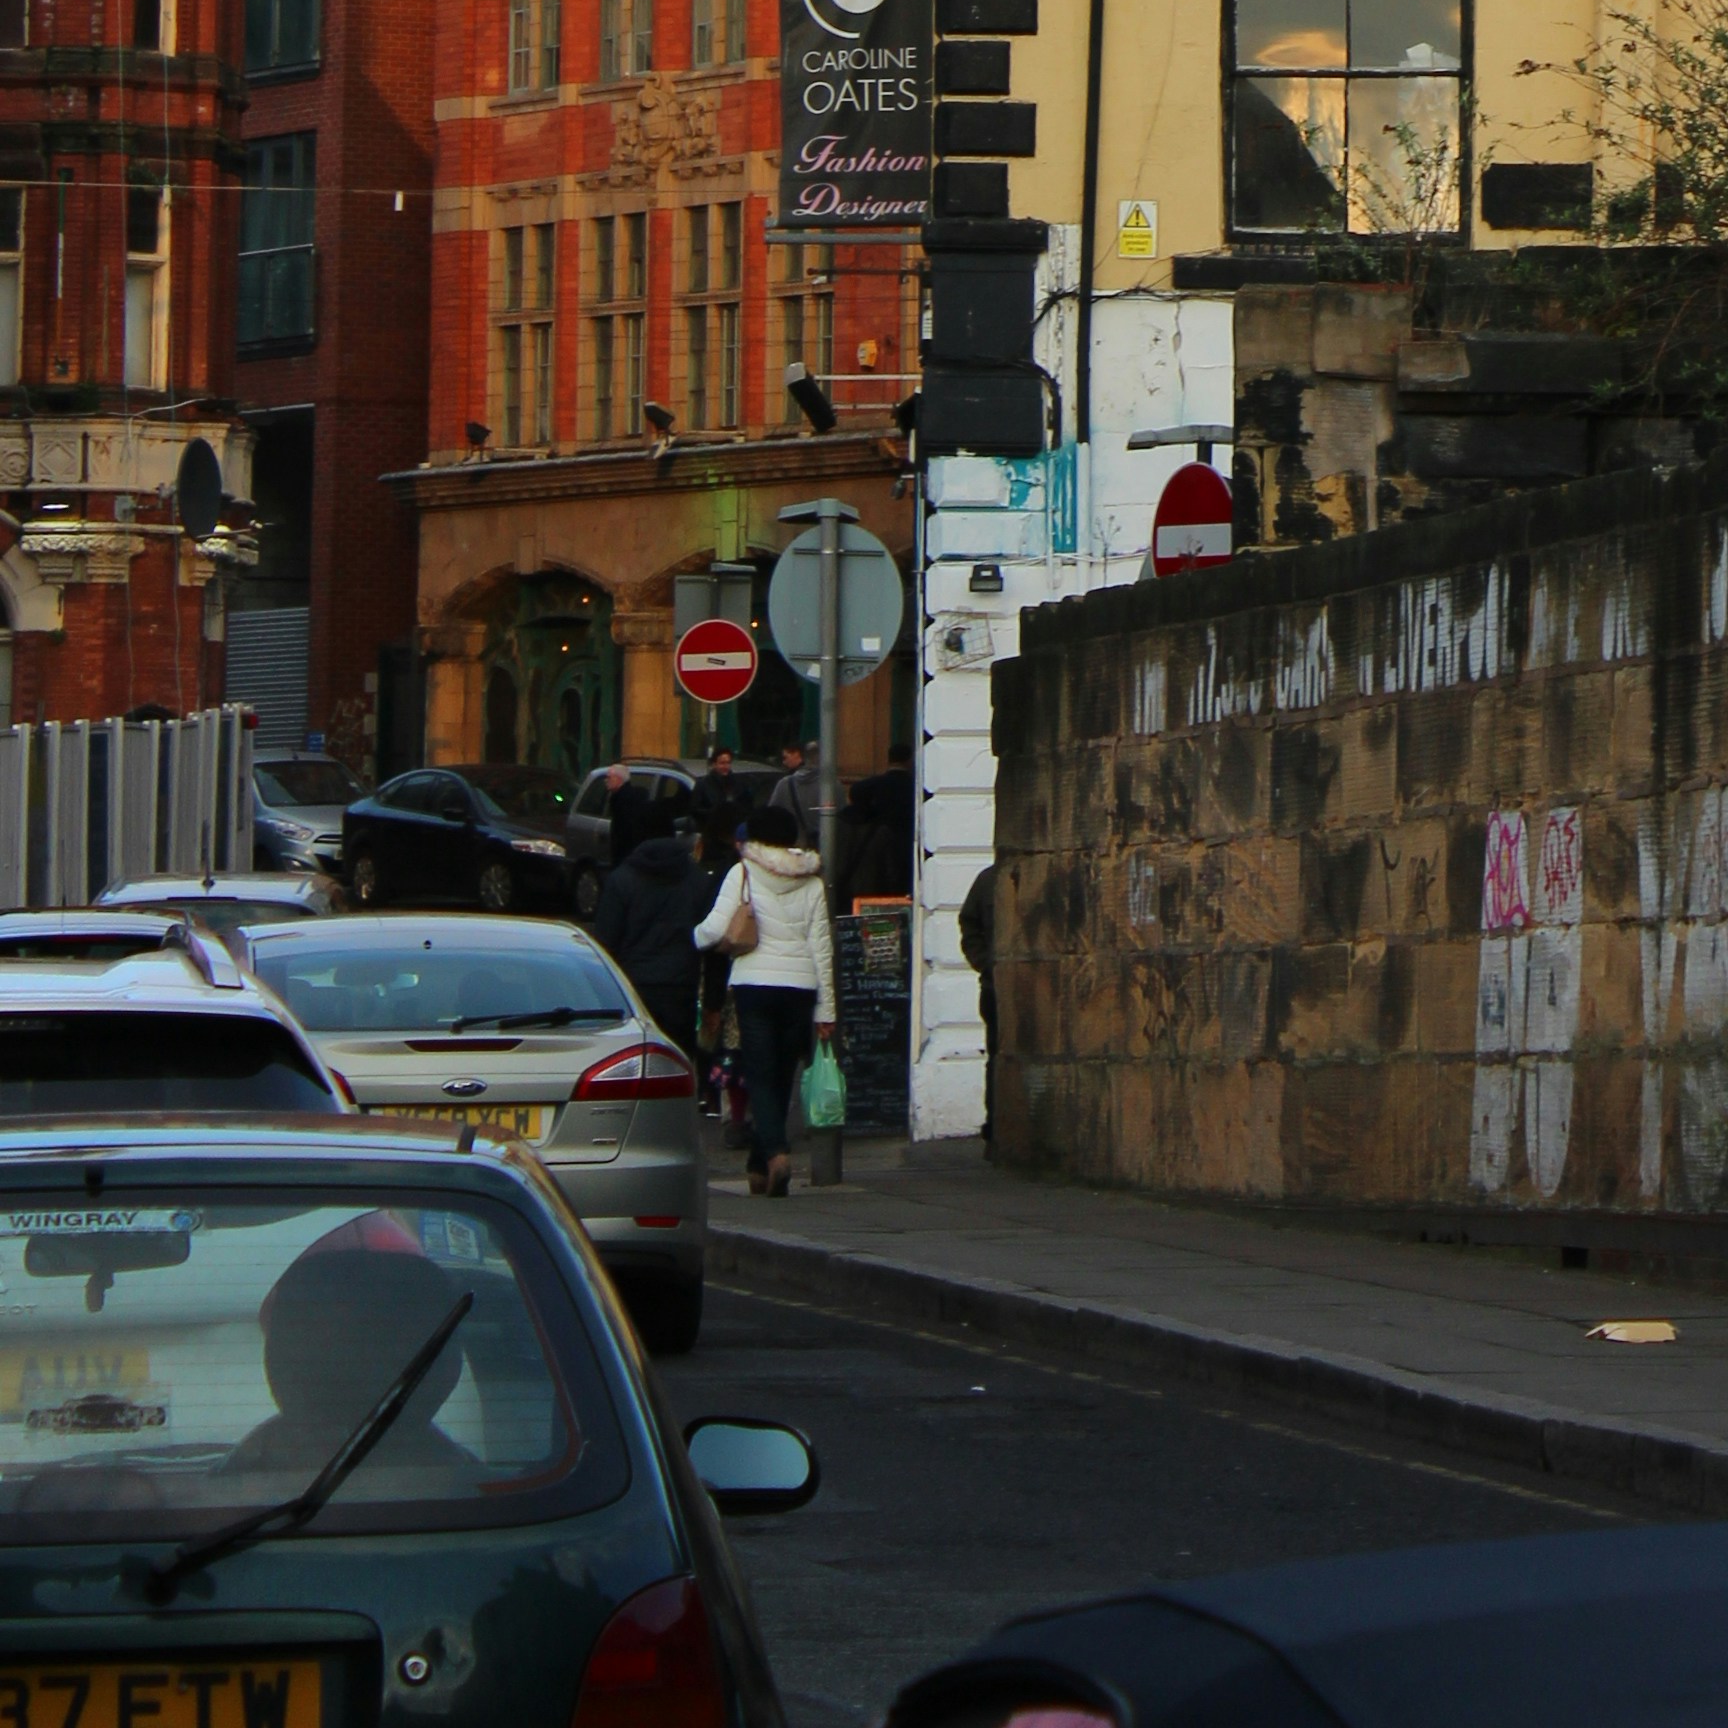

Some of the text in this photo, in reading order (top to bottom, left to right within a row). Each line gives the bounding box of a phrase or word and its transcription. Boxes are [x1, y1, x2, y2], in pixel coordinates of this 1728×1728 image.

[802, 46, 917, 73] CAROLINE
[803, 78, 918, 114] OATES
[793, 134, 926, 174] Fashion
[792, 182, 927, 221] Designer
[9, 1211, 139, 1229] WINGRAY
